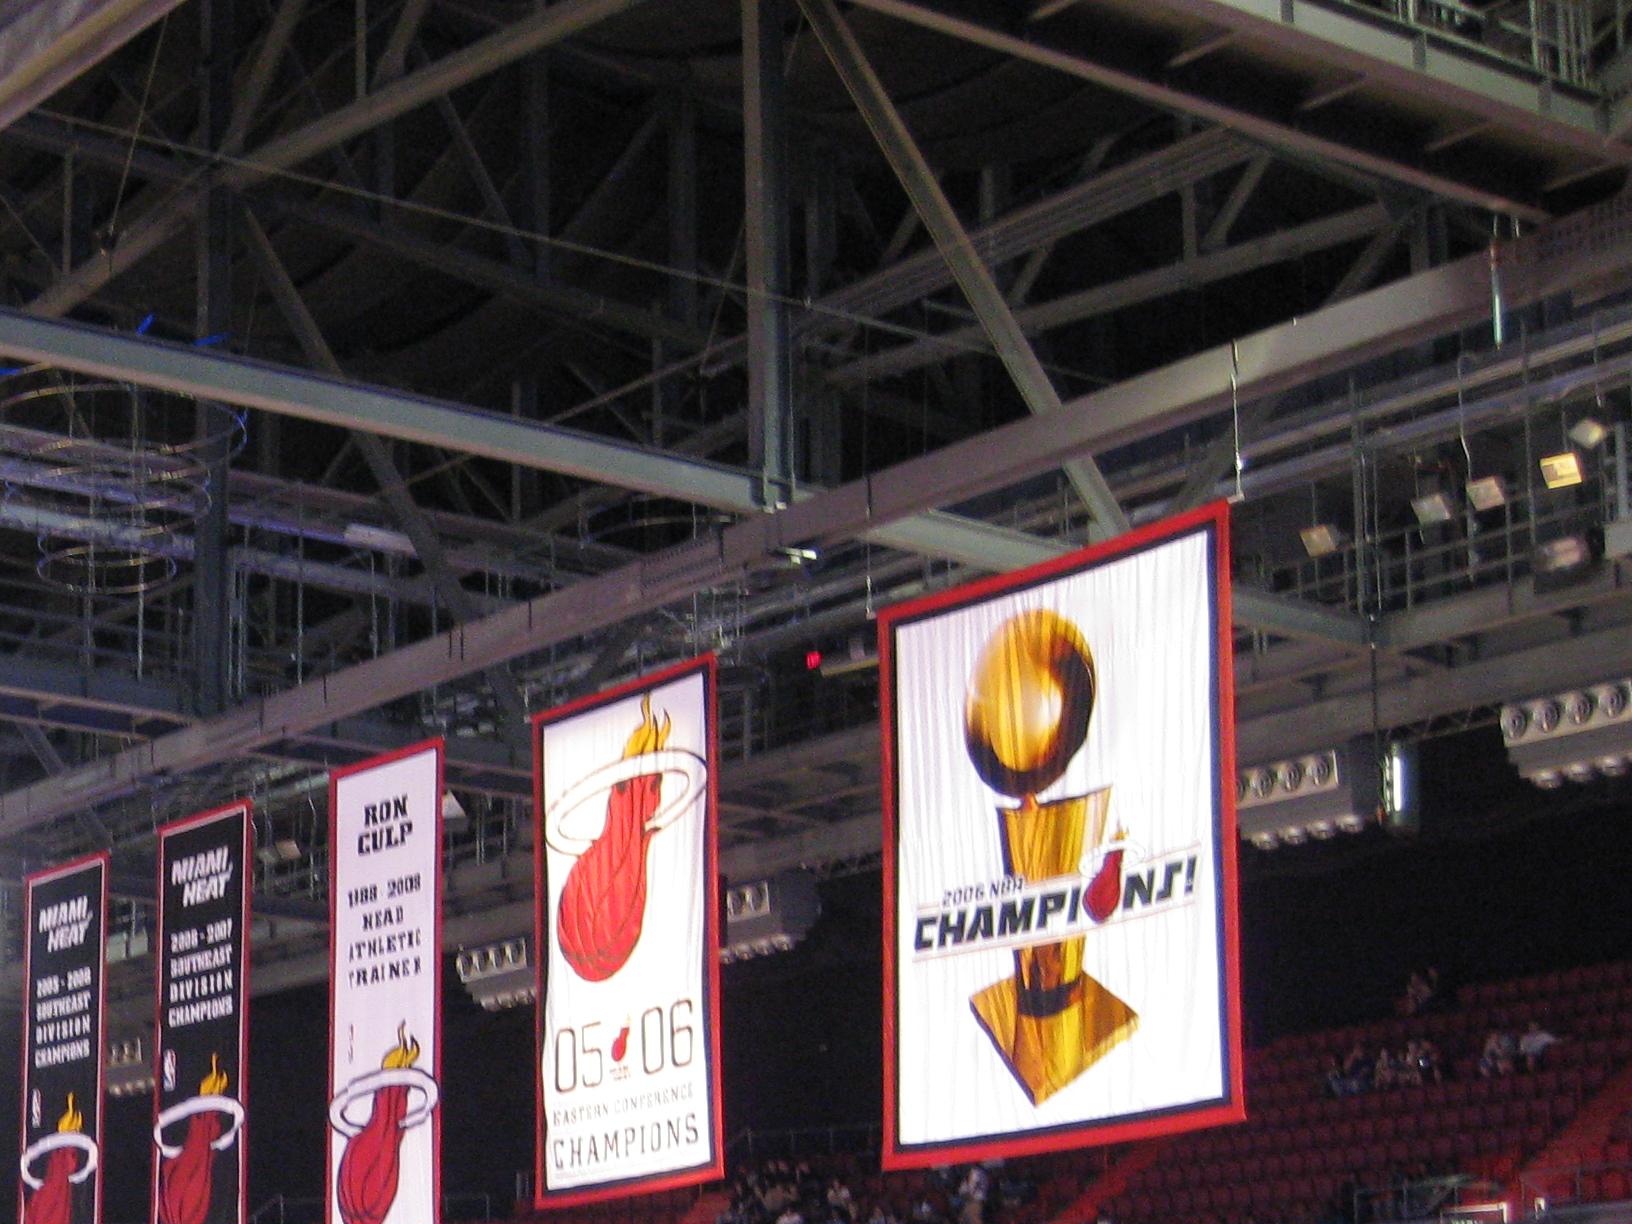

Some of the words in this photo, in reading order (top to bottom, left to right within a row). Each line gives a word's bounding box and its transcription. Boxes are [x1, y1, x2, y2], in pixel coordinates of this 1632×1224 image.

[364, 793, 408, 827] RON
[358, 820, 413, 856] CULP
[171, 845, 229, 886] MIAMI
[182, 870, 232, 907] HEAT
[990, 876, 1024, 899] NBA
[39, 895, 88, 933] MIAMI
[363, 905, 403, 931] HEAD
[47, 919, 91, 952] HEAT
[349, 928, 422, 963] ATHLETIC
[170, 943, 233, 979] SOUTHEAST
[349, 956, 422, 989] TRAINER
[170, 968, 233, 1003] DIVISION
[35, 1013, 91, 1044] DIVISION
[168, 994, 233, 1028] CHAMPIONS
[35, 1038, 90, 1068] CHAMPIONS
[641, 998, 693, 1075] 06
[555, 1021, 603, 1094] 05
[553, 1102, 608, 1127] EASTERN
[614, 1082, 693, 1114] CONFERENCE
[553, 1112, 699, 1169] CHAMPIONS
